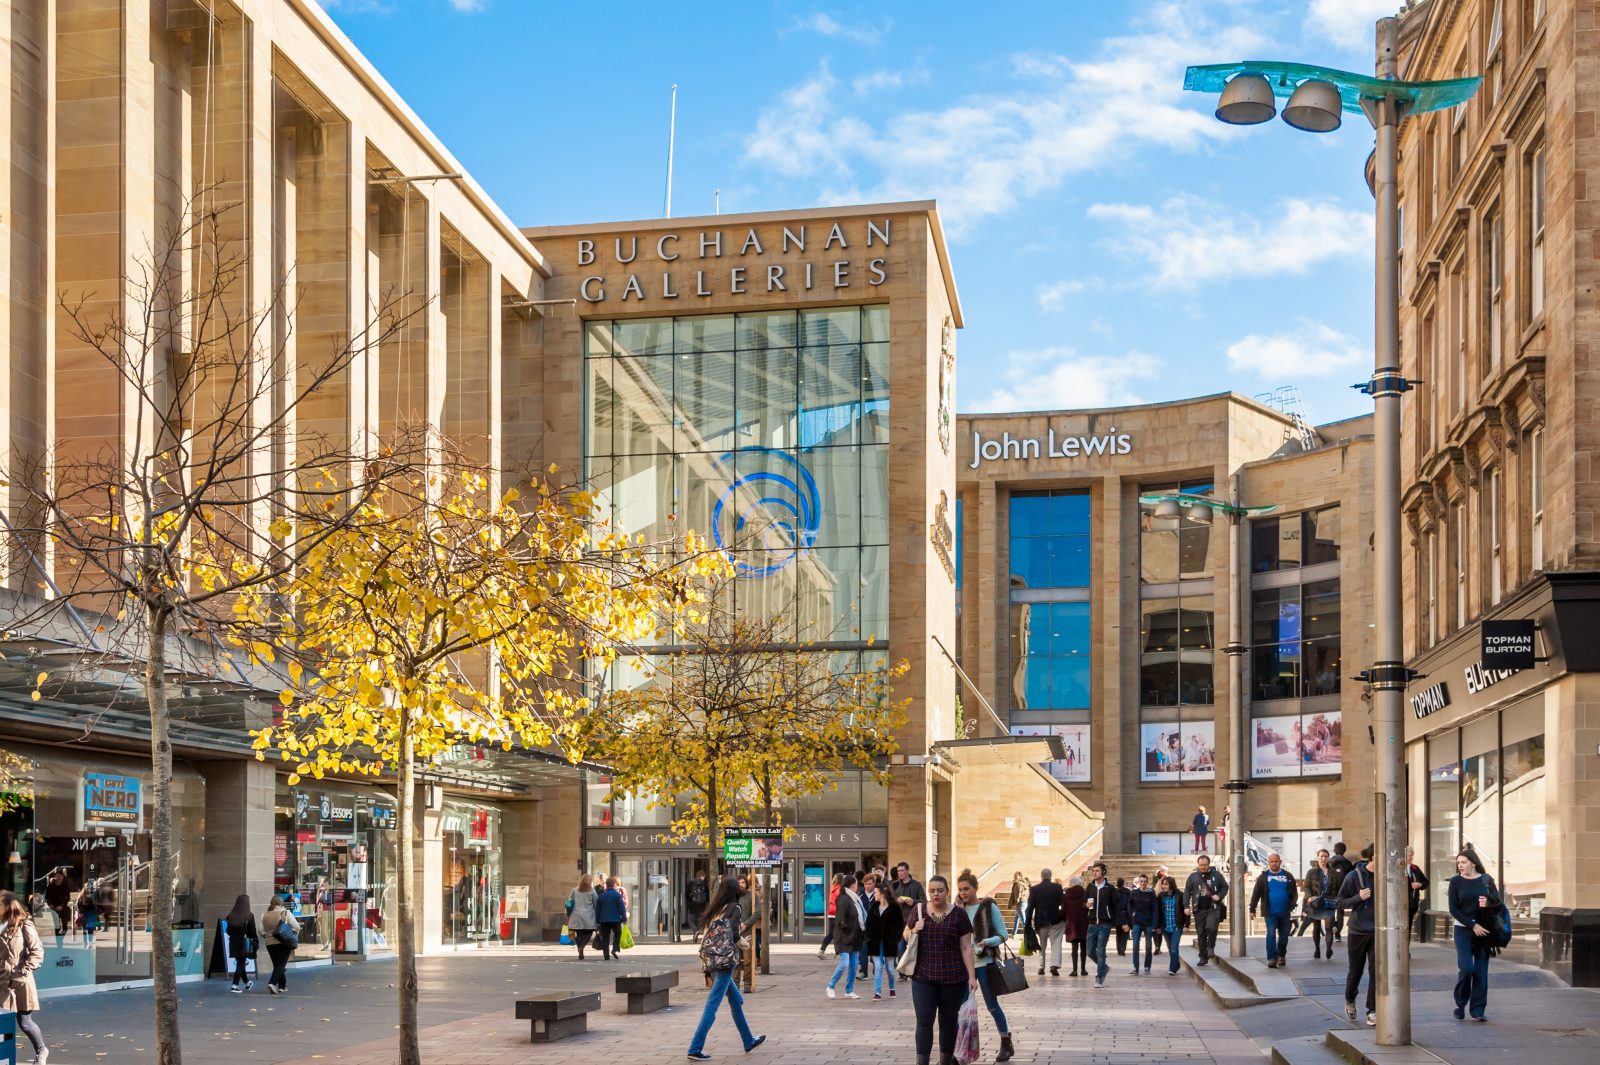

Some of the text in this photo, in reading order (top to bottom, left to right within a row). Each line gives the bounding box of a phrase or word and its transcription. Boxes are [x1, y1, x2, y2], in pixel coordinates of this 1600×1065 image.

[577, 219, 891, 267] BUCHANAN
[580, 258, 888, 302] GALLERIES
[969, 427, 1132, 469] John Lewis
[1486, 636, 1531, 644] TOPMAN
[1410, 682, 1446, 719] TOPMAN
[92, 789, 137, 810] NERO
[607, 834, 703, 844] BUCHANA
[727, 839, 749, 847] Quality
[56, 959, 74, 968] NERO
